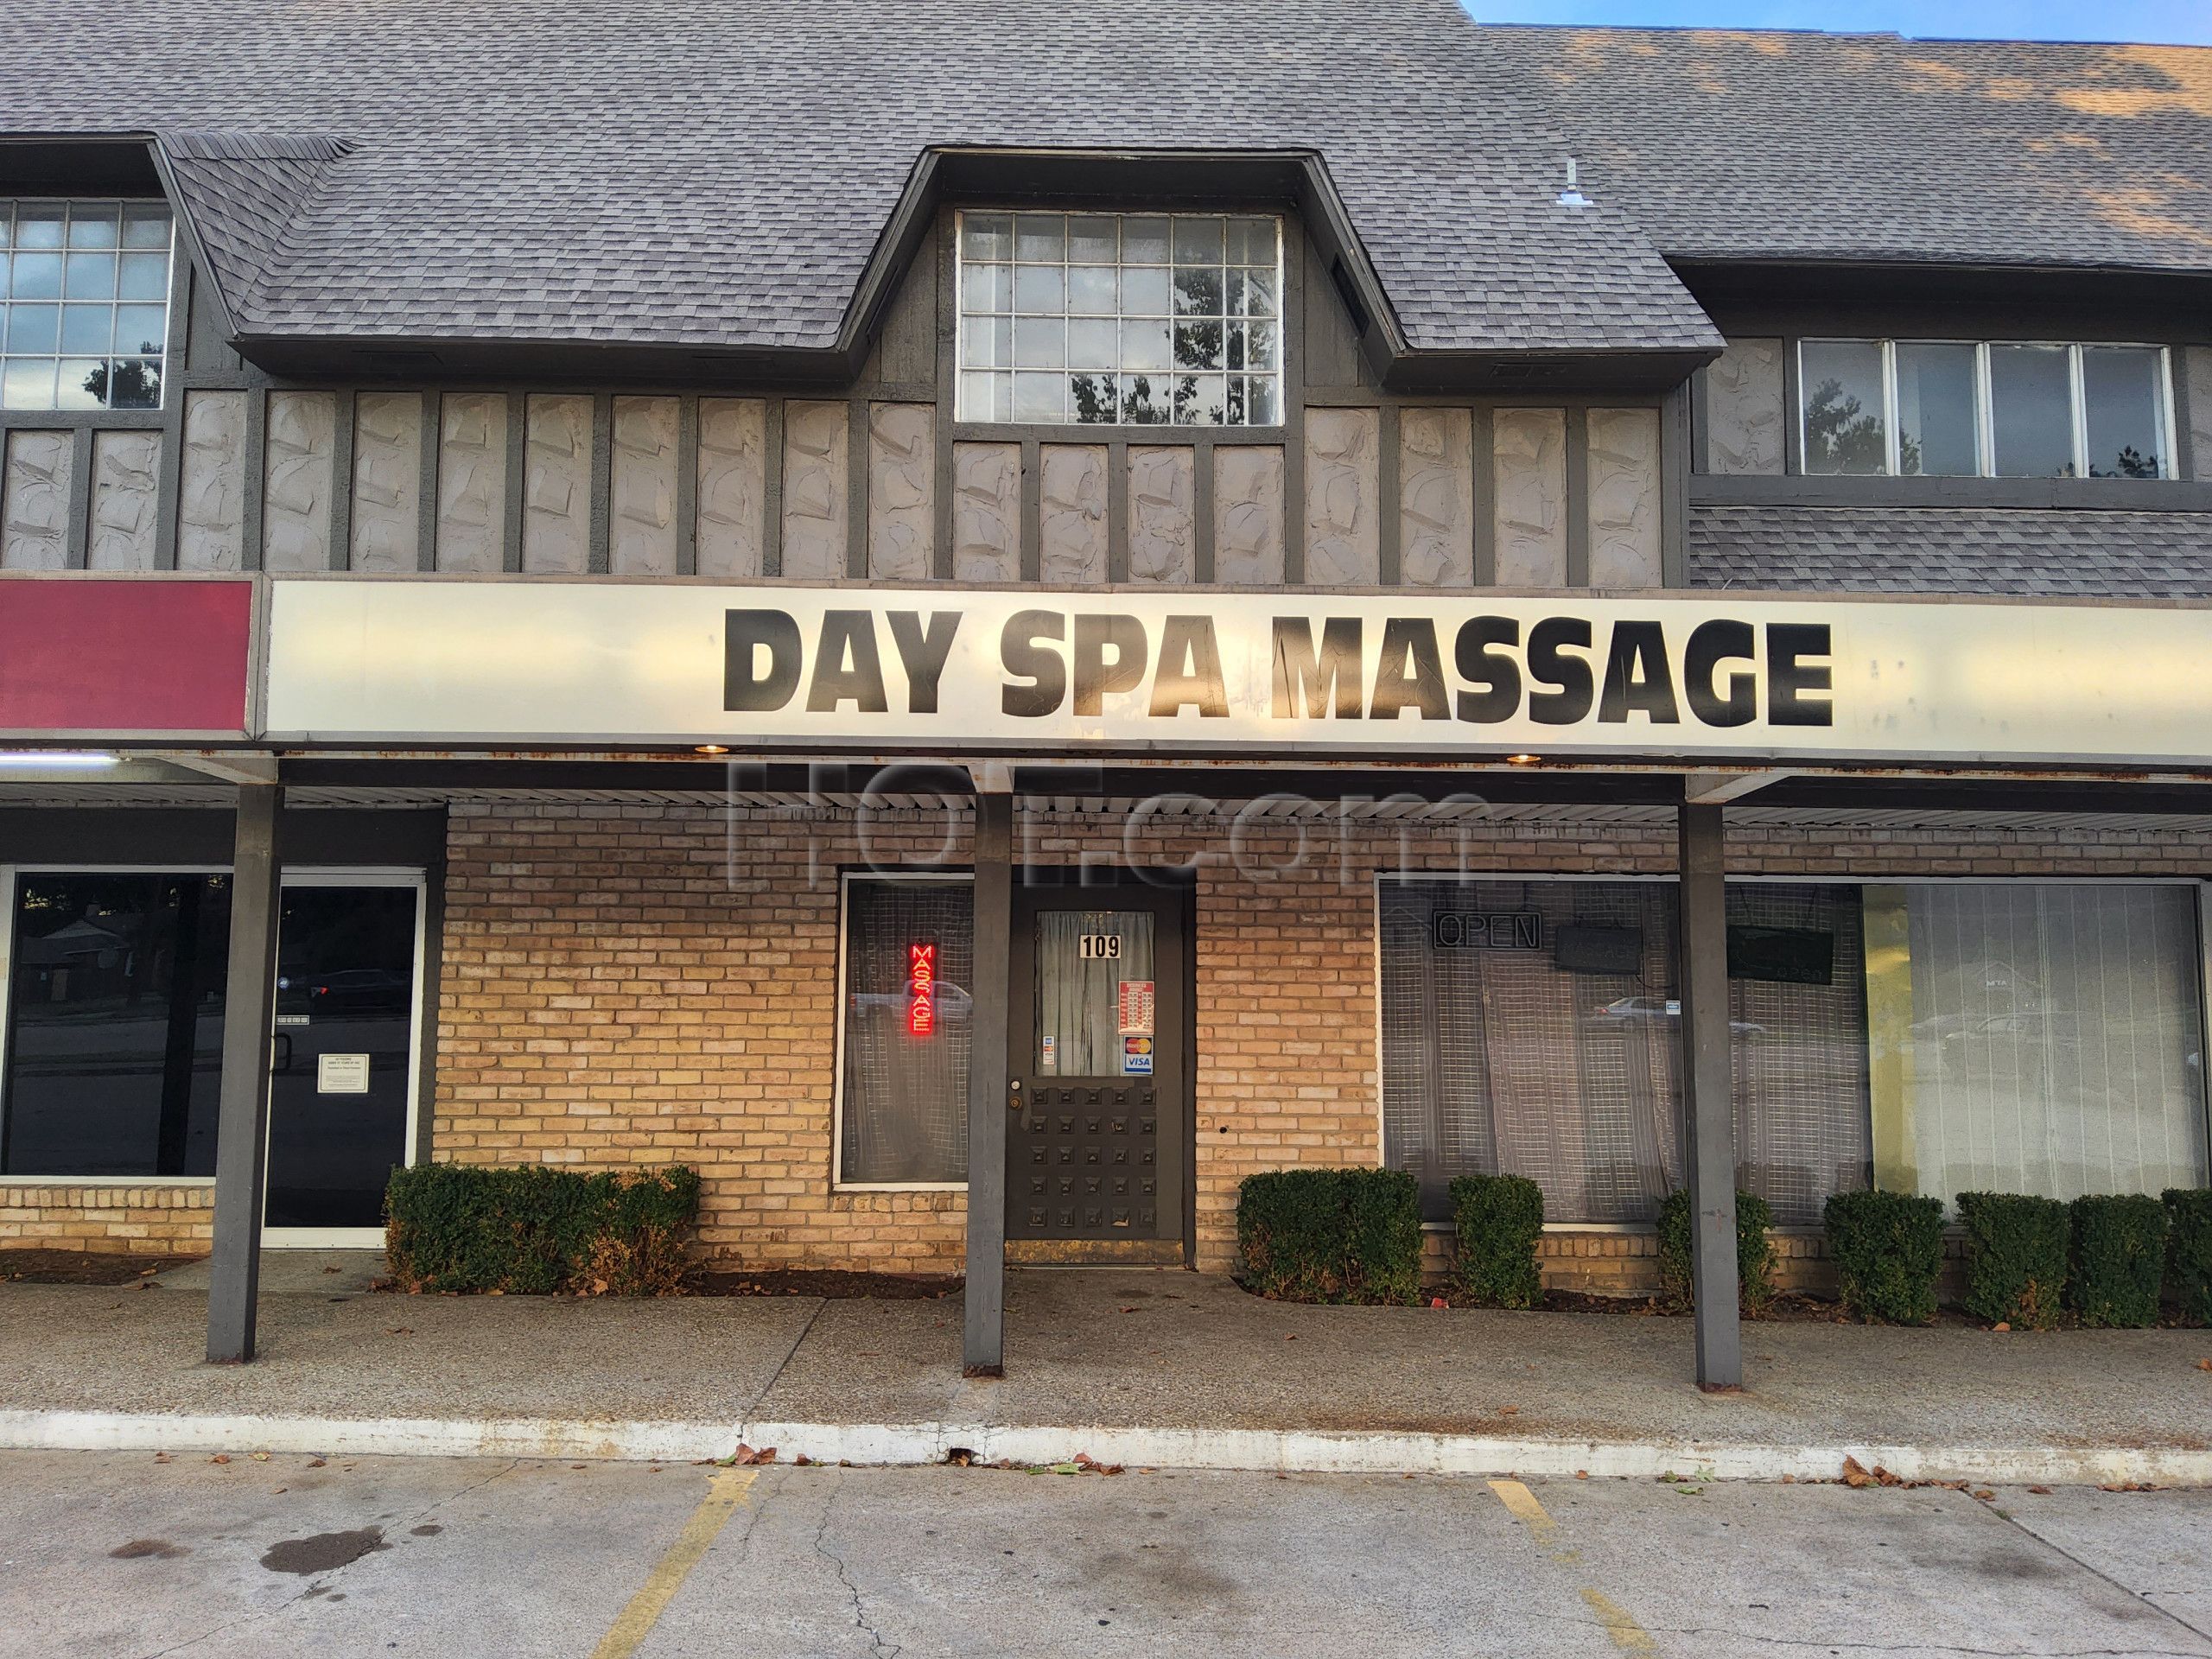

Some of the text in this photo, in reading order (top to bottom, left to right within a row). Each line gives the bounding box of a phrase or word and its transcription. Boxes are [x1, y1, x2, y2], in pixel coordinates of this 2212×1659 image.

[724, 608, 1834, 728] DAY SPA MASSAGE
[1083, 936, 1119, 957] 109
[1440, 915, 1535, 947] OPEN
[912, 944, 932, 1032] MASSAGE
[1128, 1057, 1150, 1066] VISA
